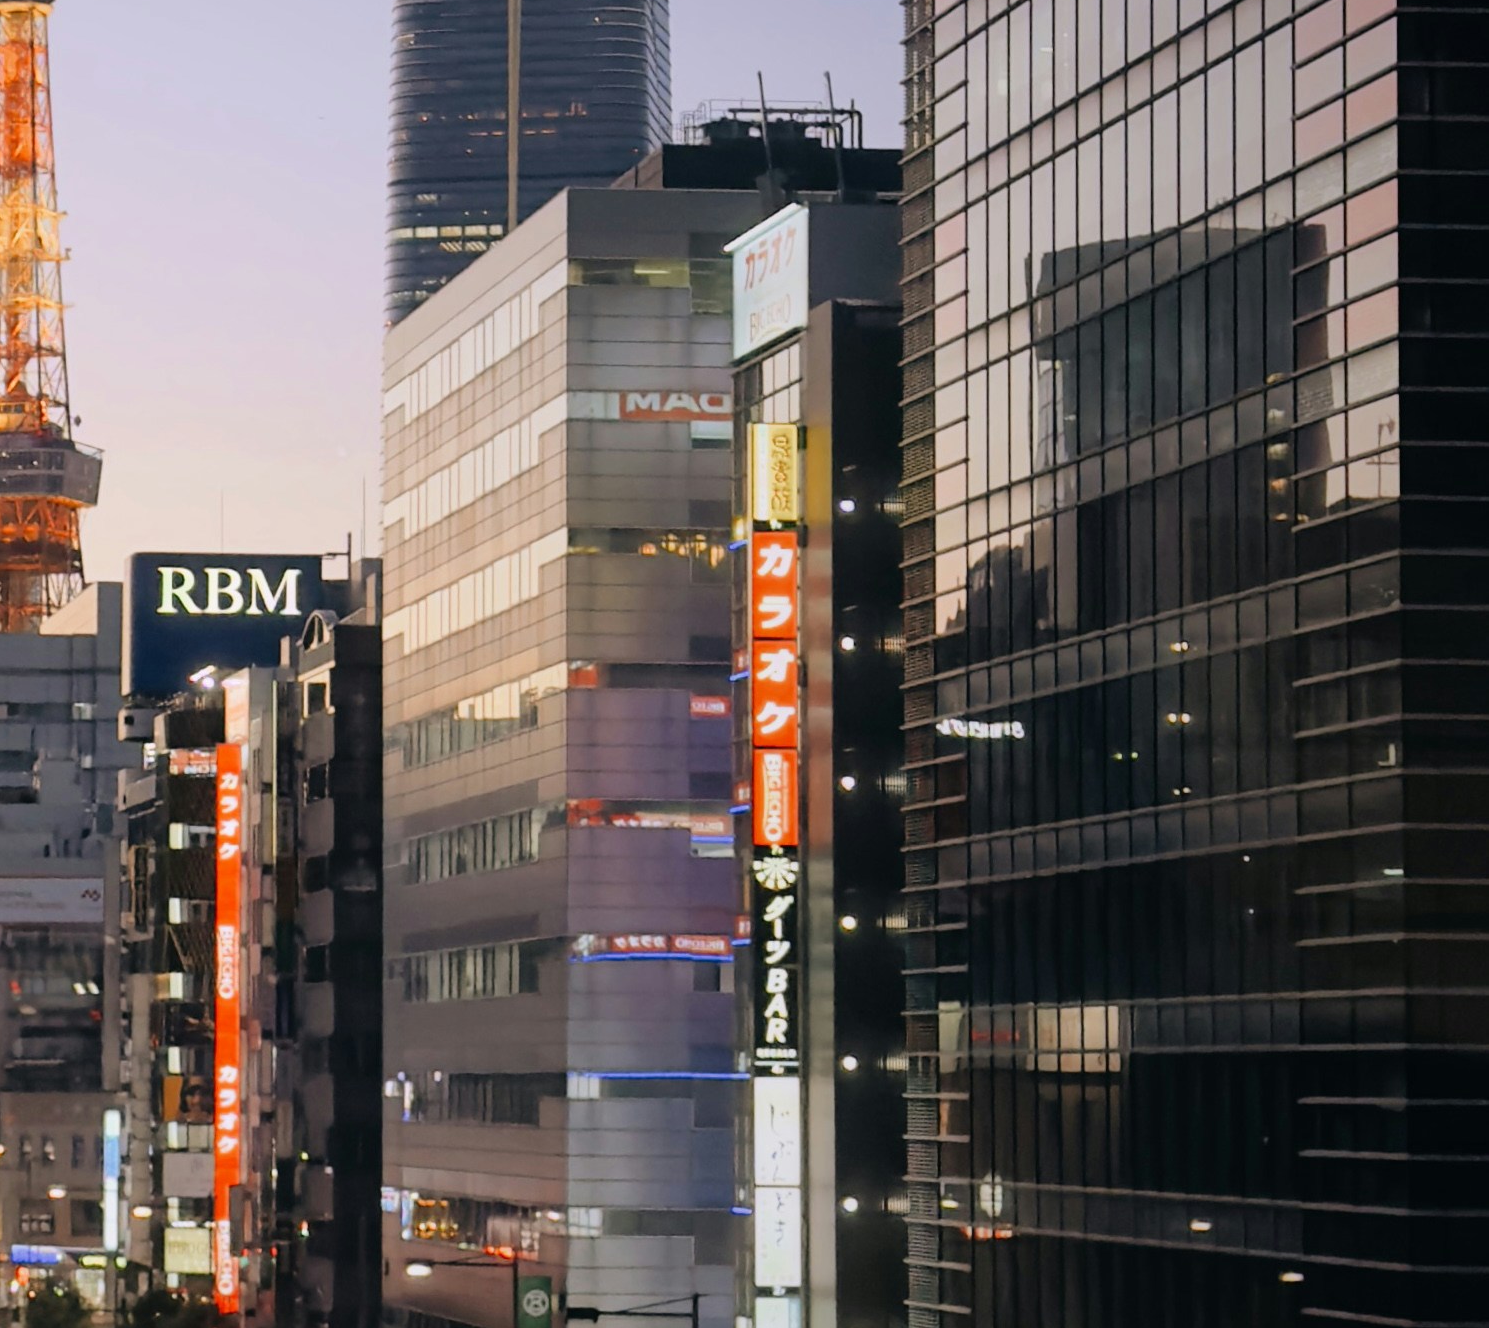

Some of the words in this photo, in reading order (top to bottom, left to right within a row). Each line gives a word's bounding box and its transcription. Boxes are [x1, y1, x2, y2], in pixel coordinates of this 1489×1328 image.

[744, 226, 796, 291] カラオケ
[156, 566, 303, 616] RBM
[756, 544, 795, 734] カラオケ
[763, 754, 782, 789] BIG
[220, 773, 239, 860] カラオケ
[764, 790, 782, 842] ECHO
[219, 925, 234, 954] BIG
[219, 955, 235, 1000] ECHO
[217, 1065, 238, 1154] カラオケ
